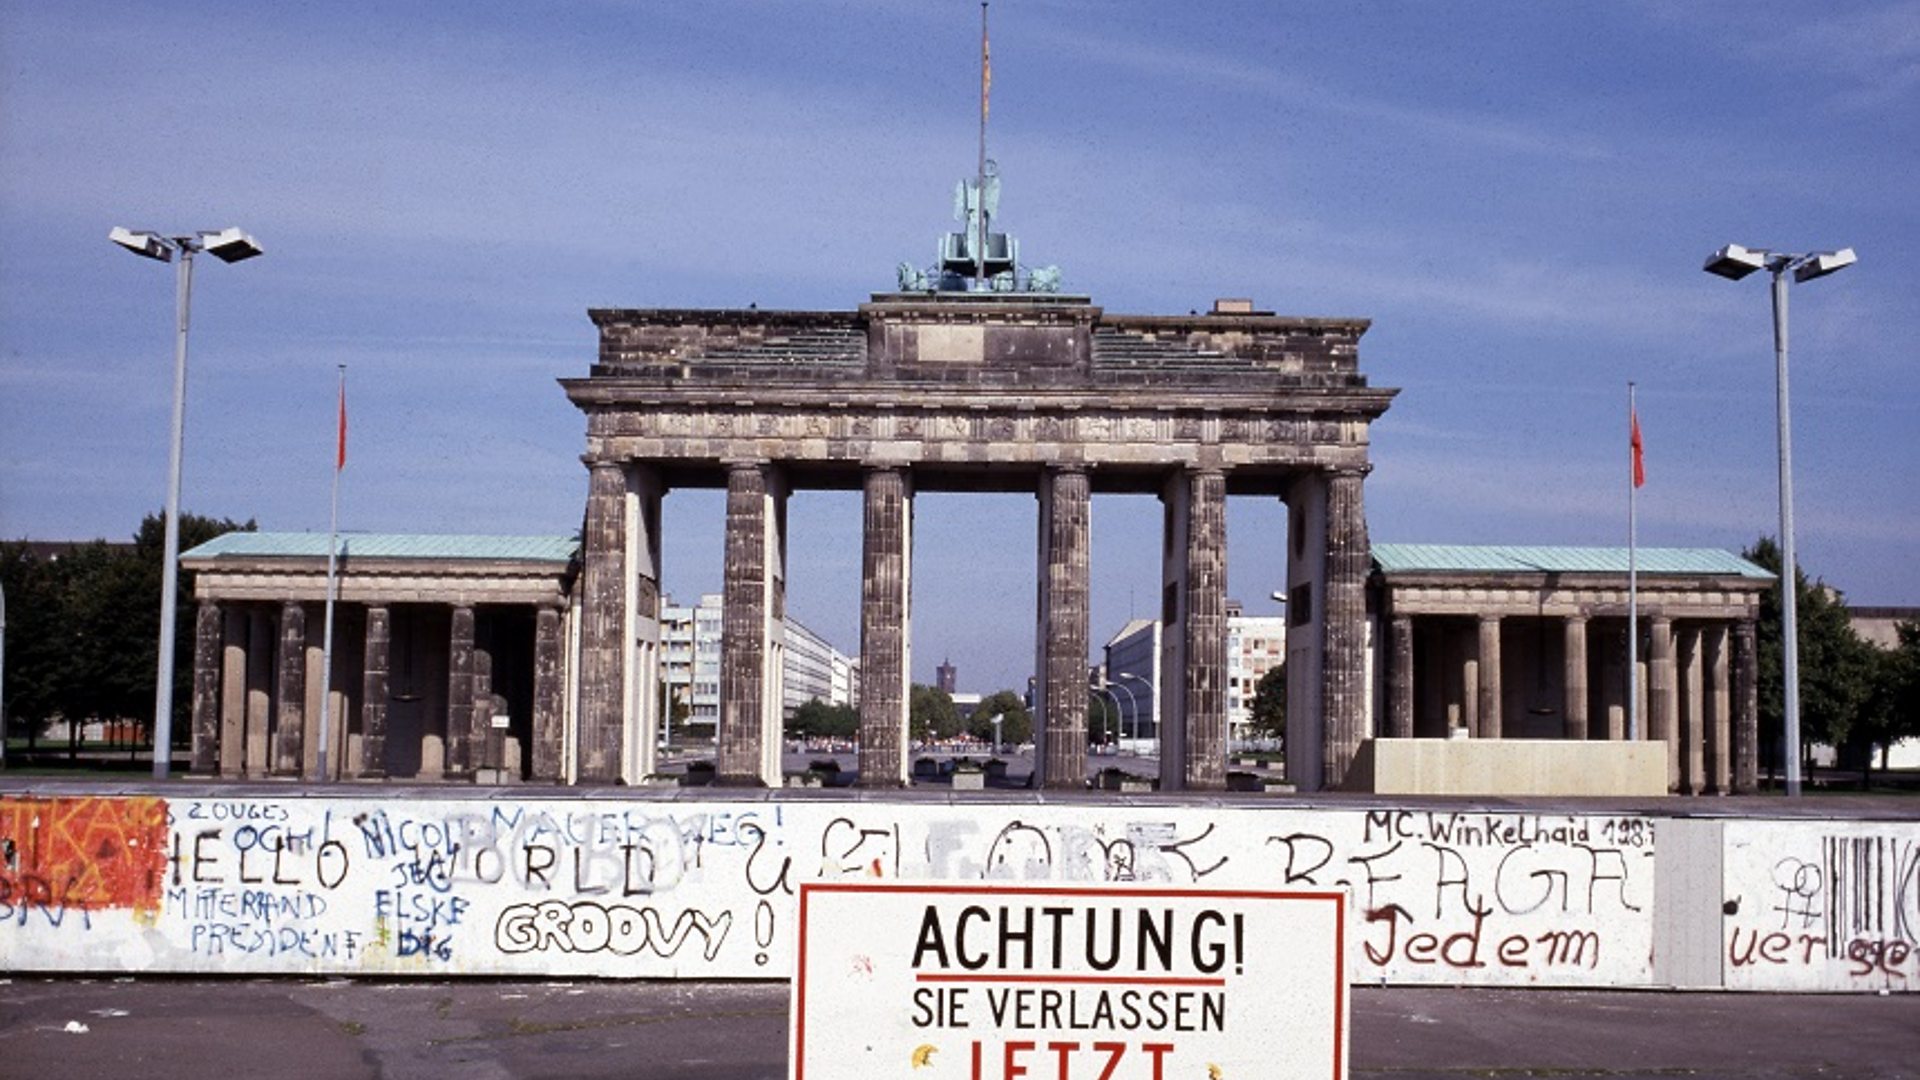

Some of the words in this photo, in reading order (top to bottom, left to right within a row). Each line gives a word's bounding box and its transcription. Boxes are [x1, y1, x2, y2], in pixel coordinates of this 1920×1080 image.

[911, 905, 1244, 975] ACHTUNG!
[911, 987, 969, 1028] SIE
[987, 988, 1225, 1032] VERLASSEN
